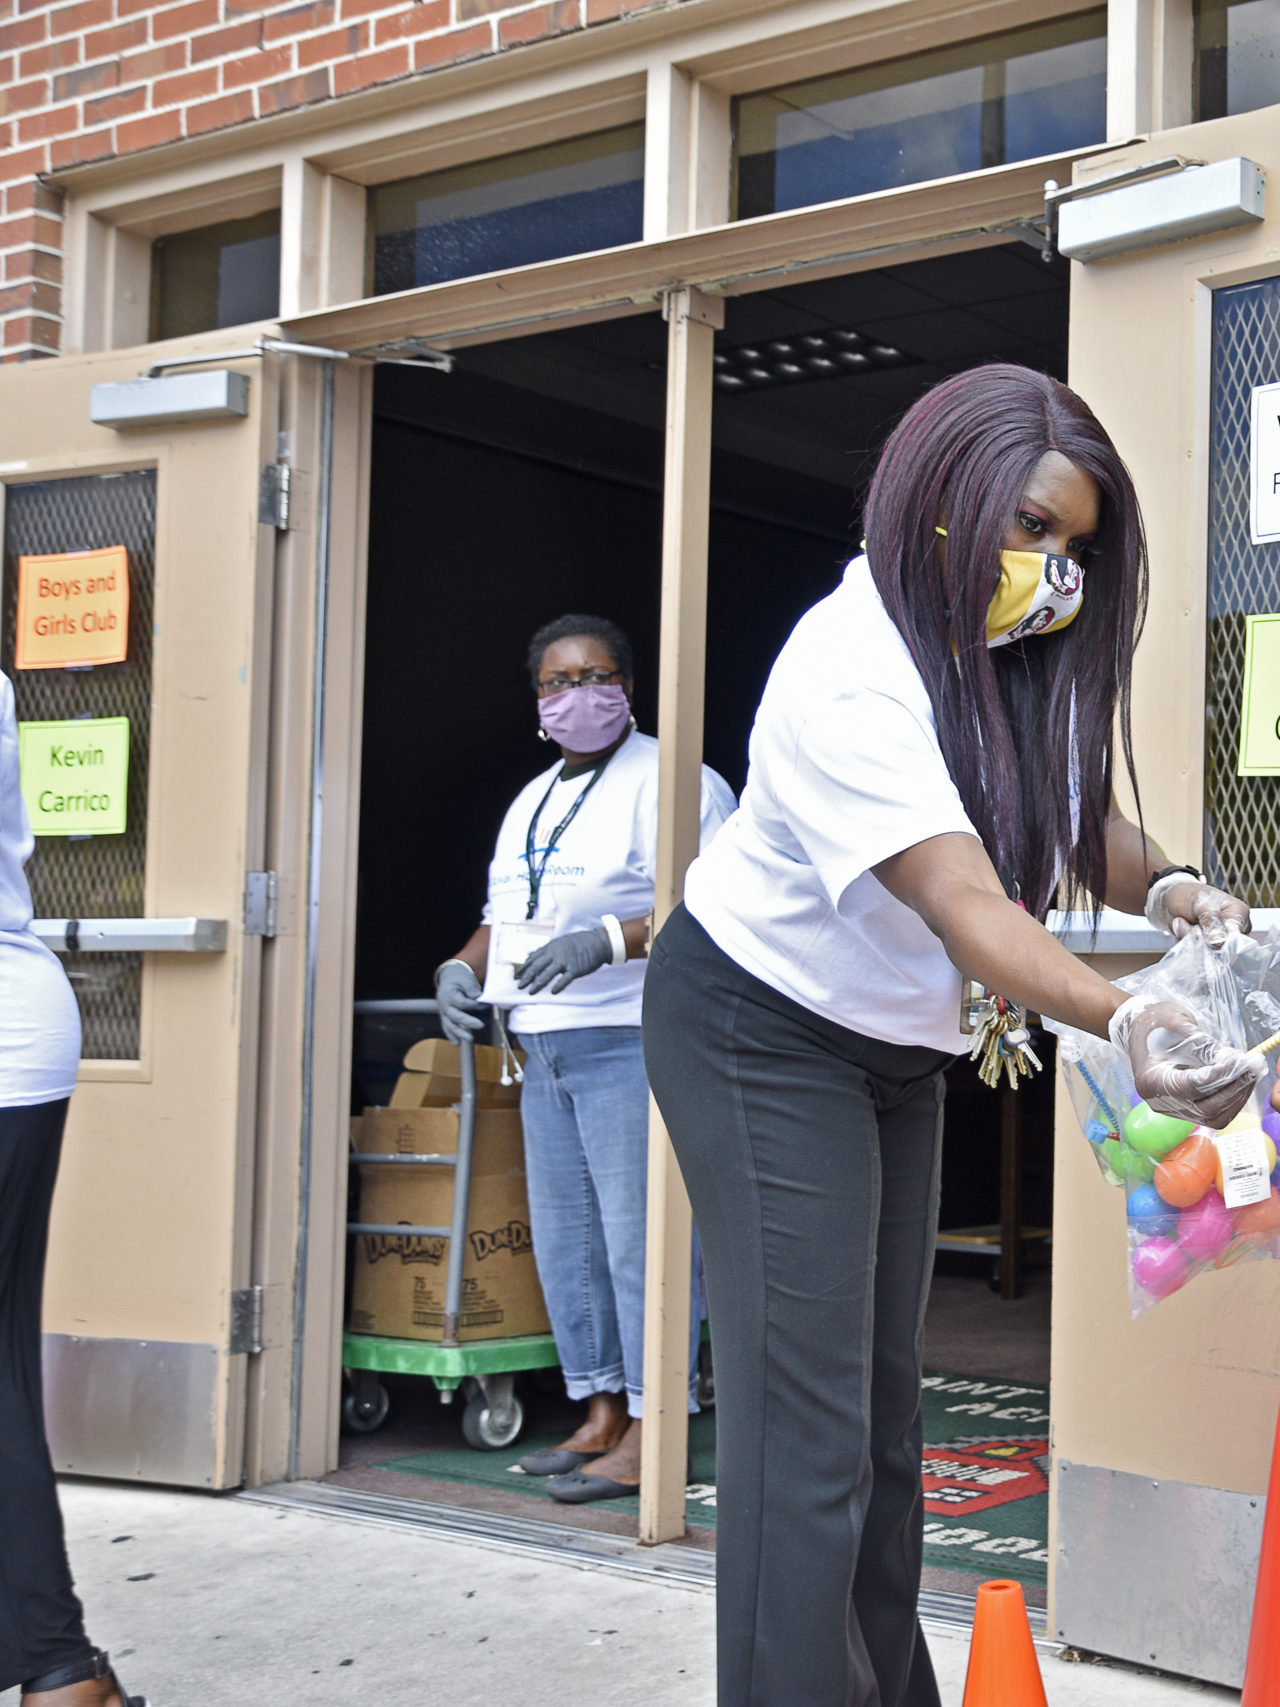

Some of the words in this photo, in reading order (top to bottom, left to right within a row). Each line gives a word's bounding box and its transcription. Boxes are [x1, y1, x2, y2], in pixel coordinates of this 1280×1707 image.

[38, 577, 81, 601] Boys
[86, 570, 116, 594] and
[34, 614, 77, 637] Girls
[81, 609, 117, 633] Club
[50, 743, 104, 768] Kevin
[38, 789, 110, 813] Carrico
